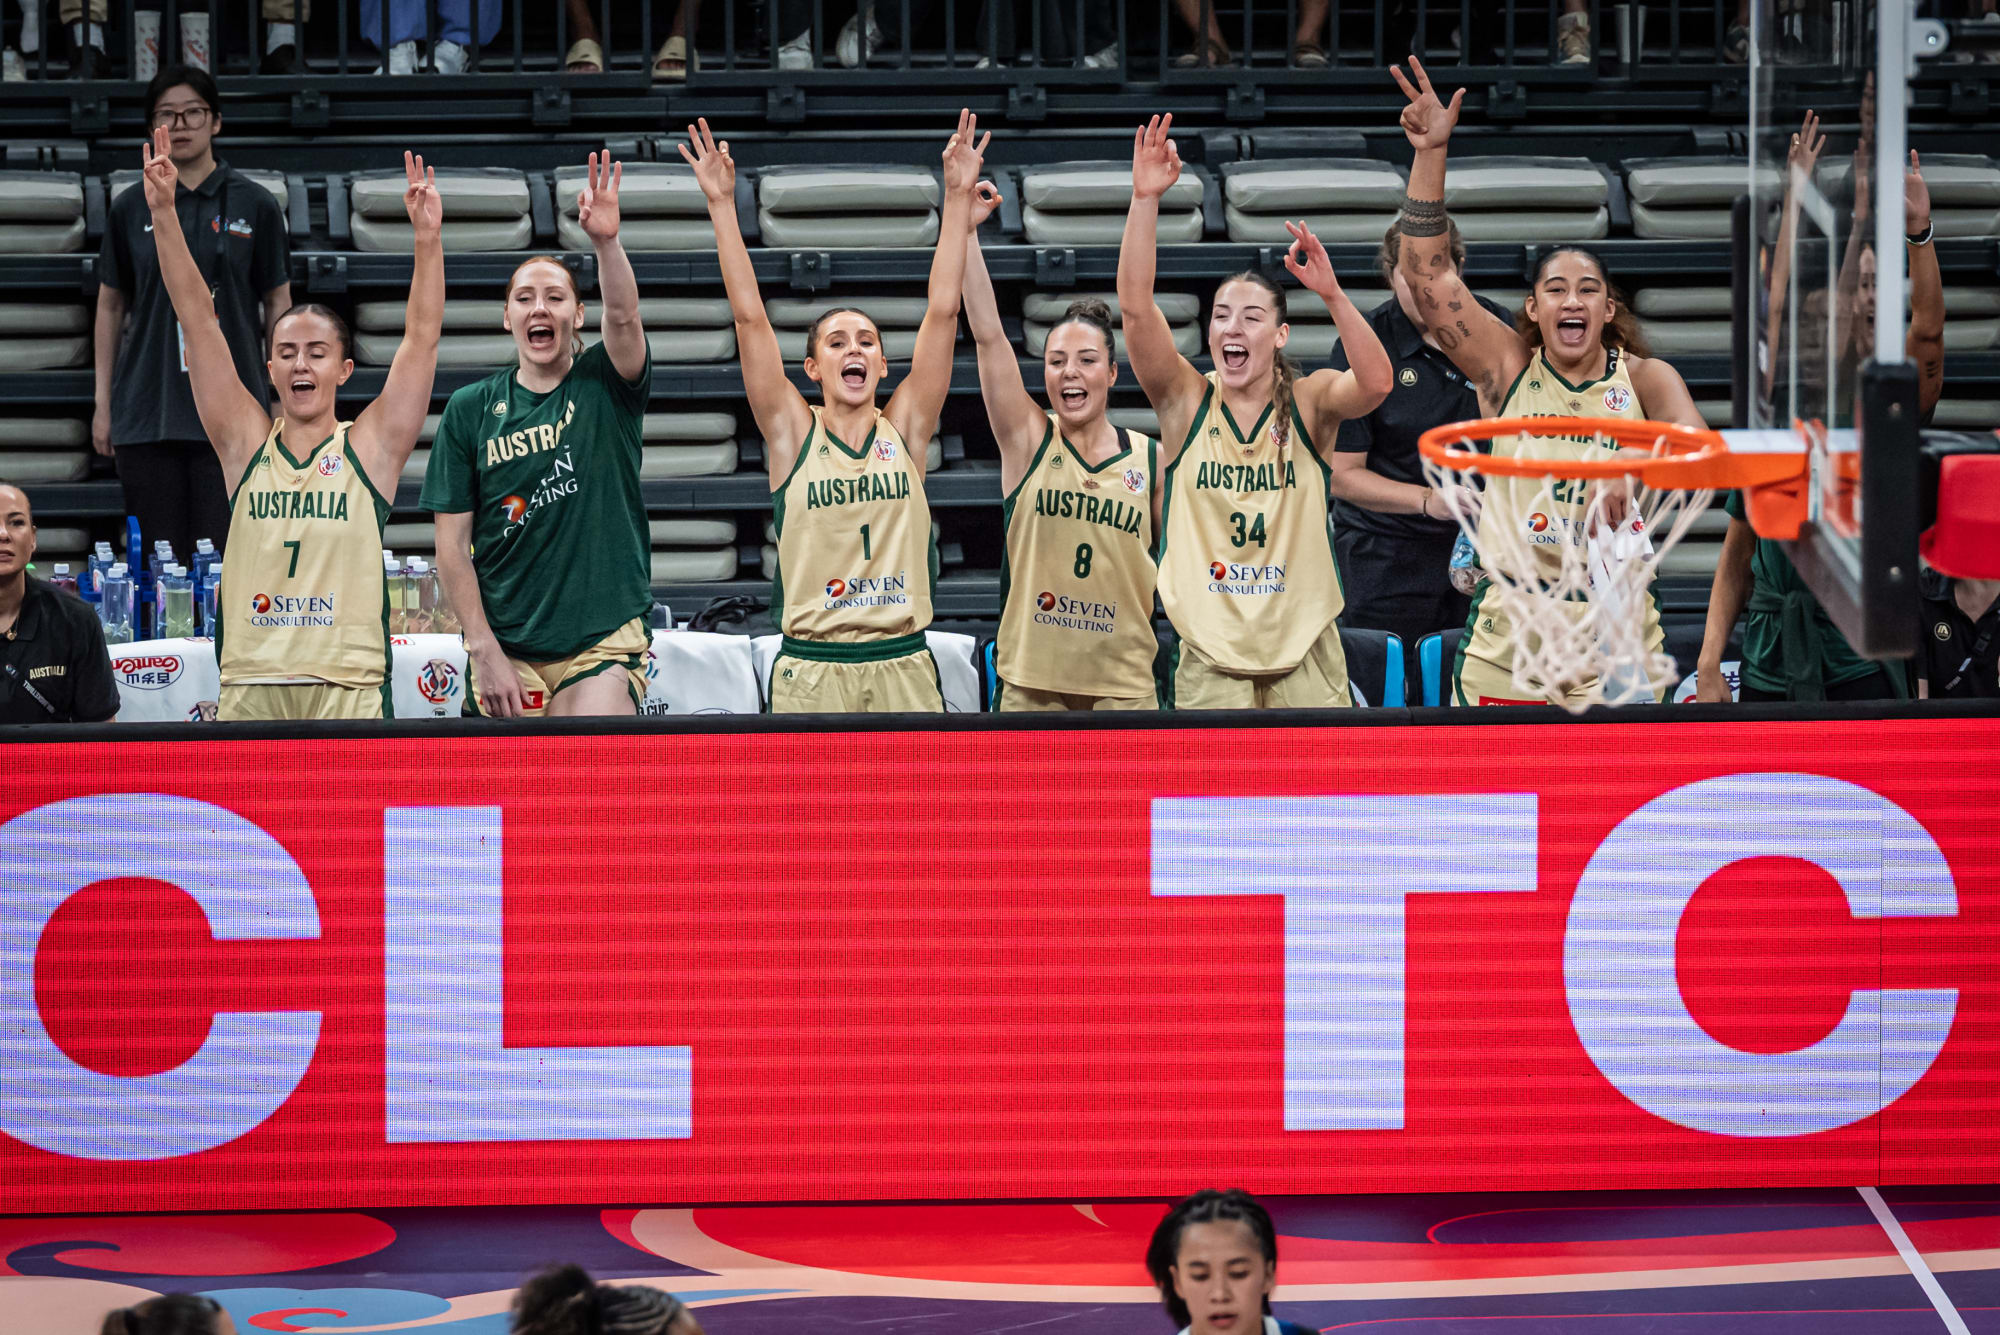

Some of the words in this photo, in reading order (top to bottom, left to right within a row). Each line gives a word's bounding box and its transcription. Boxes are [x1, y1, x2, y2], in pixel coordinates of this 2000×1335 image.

[1196, 460, 1296, 492] AUSTRALA
[807, 472, 910, 510] AUSTRALIA
[249, 490, 348, 521] AUSTRALIA
[1036, 488, 1142, 539] AUSTRALIA
[860, 523, 871, 560] 1
[1229, 511, 1267, 548] 34
[283, 540, 300, 578] 7
[1073, 543, 1093, 579] 8
[1229, 564, 1286, 581] SEVEN
[848, 576, 904, 595] SEVEN
[1208, 582, 1285, 594] CONSULTING
[273, 595, 333, 613] SEVEN
[824, 594, 906, 610] CONSULTING
[1057, 596, 1116, 619] SEVEN
[251, 616, 333, 627] CONSULTING
[1034, 613, 1114, 633] CONSULTING
